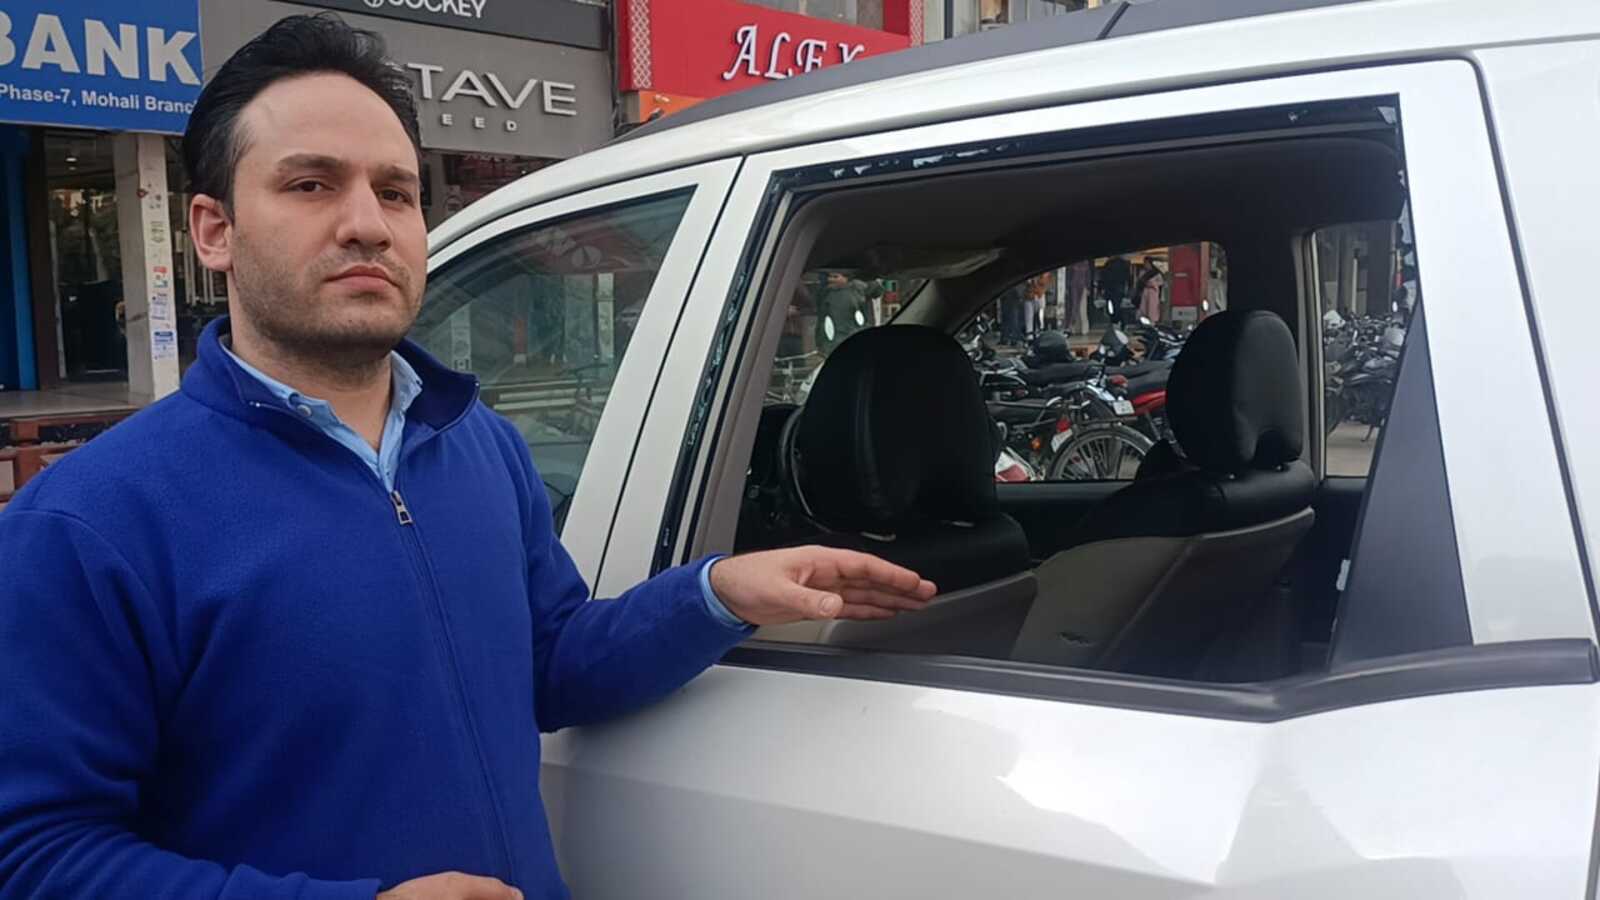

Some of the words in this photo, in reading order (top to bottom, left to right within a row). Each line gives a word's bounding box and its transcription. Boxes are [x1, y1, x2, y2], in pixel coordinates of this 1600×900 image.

[388, 0, 486, 18] CKEY
[385, 61, 578, 117] TAVE
[81, 90, 140, 110] Mohali
[144, 96, 198, 114] Branc
